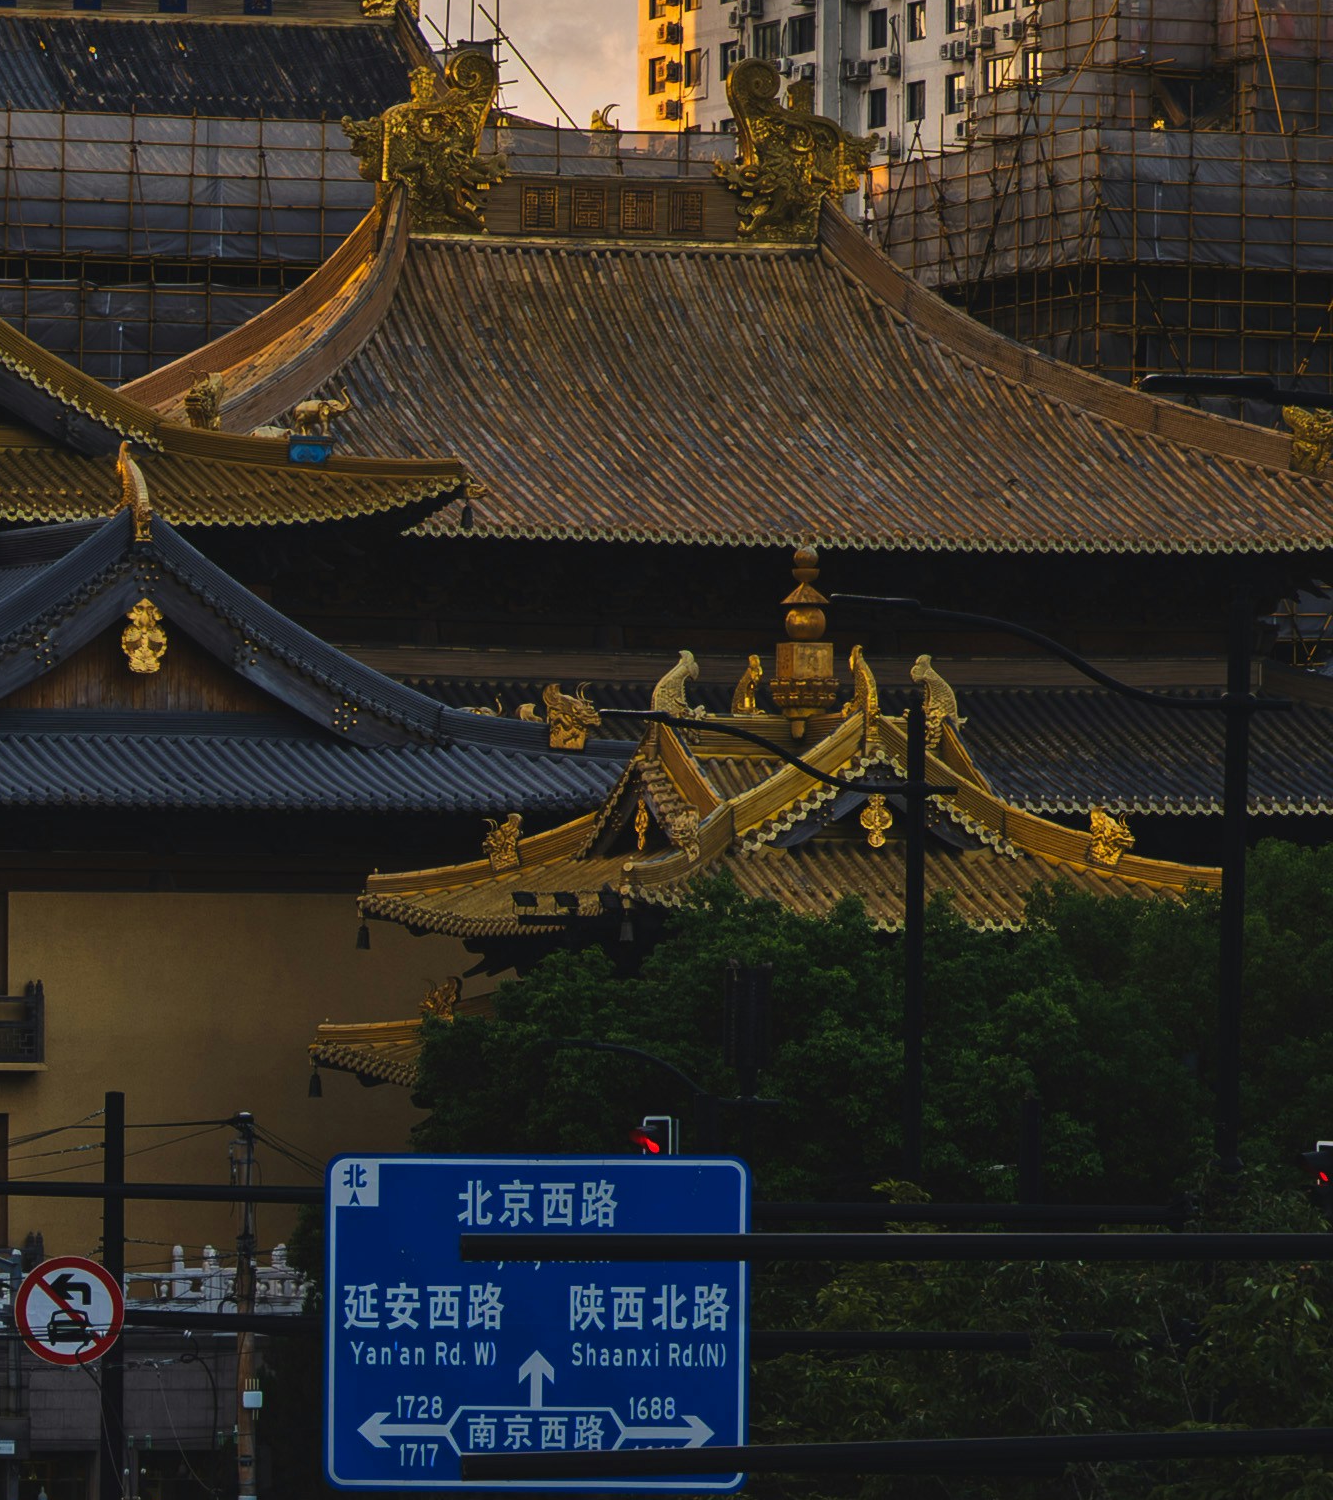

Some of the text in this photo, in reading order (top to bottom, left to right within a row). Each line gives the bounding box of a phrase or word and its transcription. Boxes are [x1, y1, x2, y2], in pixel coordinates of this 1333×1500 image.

[342, 1163, 368, 1189] 北
[457, 1179, 618, 1227] 北京西路
[343, 1283, 504, 1331] 延安西路
[569, 1284, 730, 1331] 陕西北路
[350, 1341, 425, 1366] Yan'an
[571, 1342, 727, 1367] Shaanxi Rd.(N)
[397, 1396, 443, 1418] 1728
[630, 1397, 676, 1420] 1688
[467, 1414, 605, 1450] 南京西路
[400, 1443, 439, 1466] 1717
